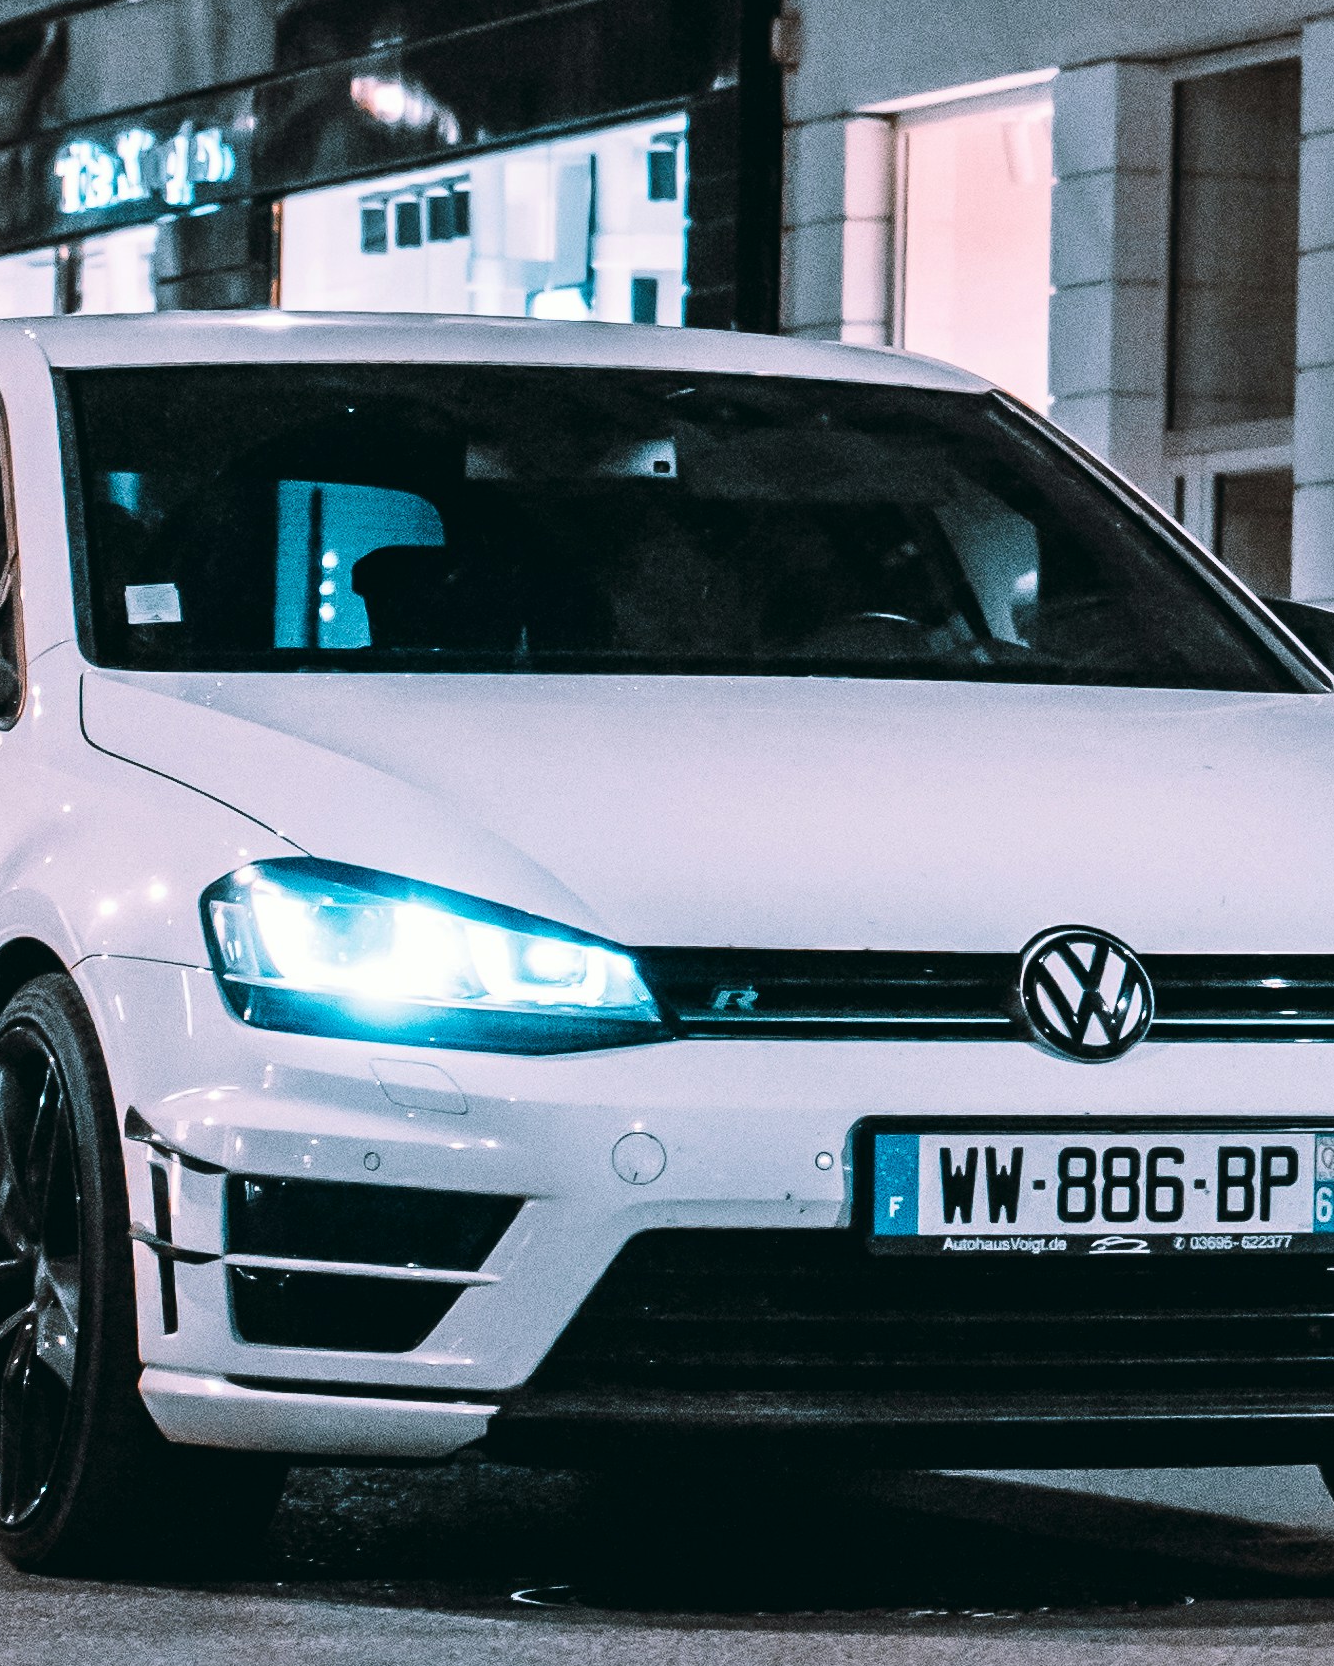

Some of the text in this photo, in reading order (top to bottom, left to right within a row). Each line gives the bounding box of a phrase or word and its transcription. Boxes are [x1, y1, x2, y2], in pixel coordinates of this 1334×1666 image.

[712, 985, 758, 1011] R
[889, 1196, 903, 1218] F
[943, 1236, 1067, 1254] AutohausVoigt.de
